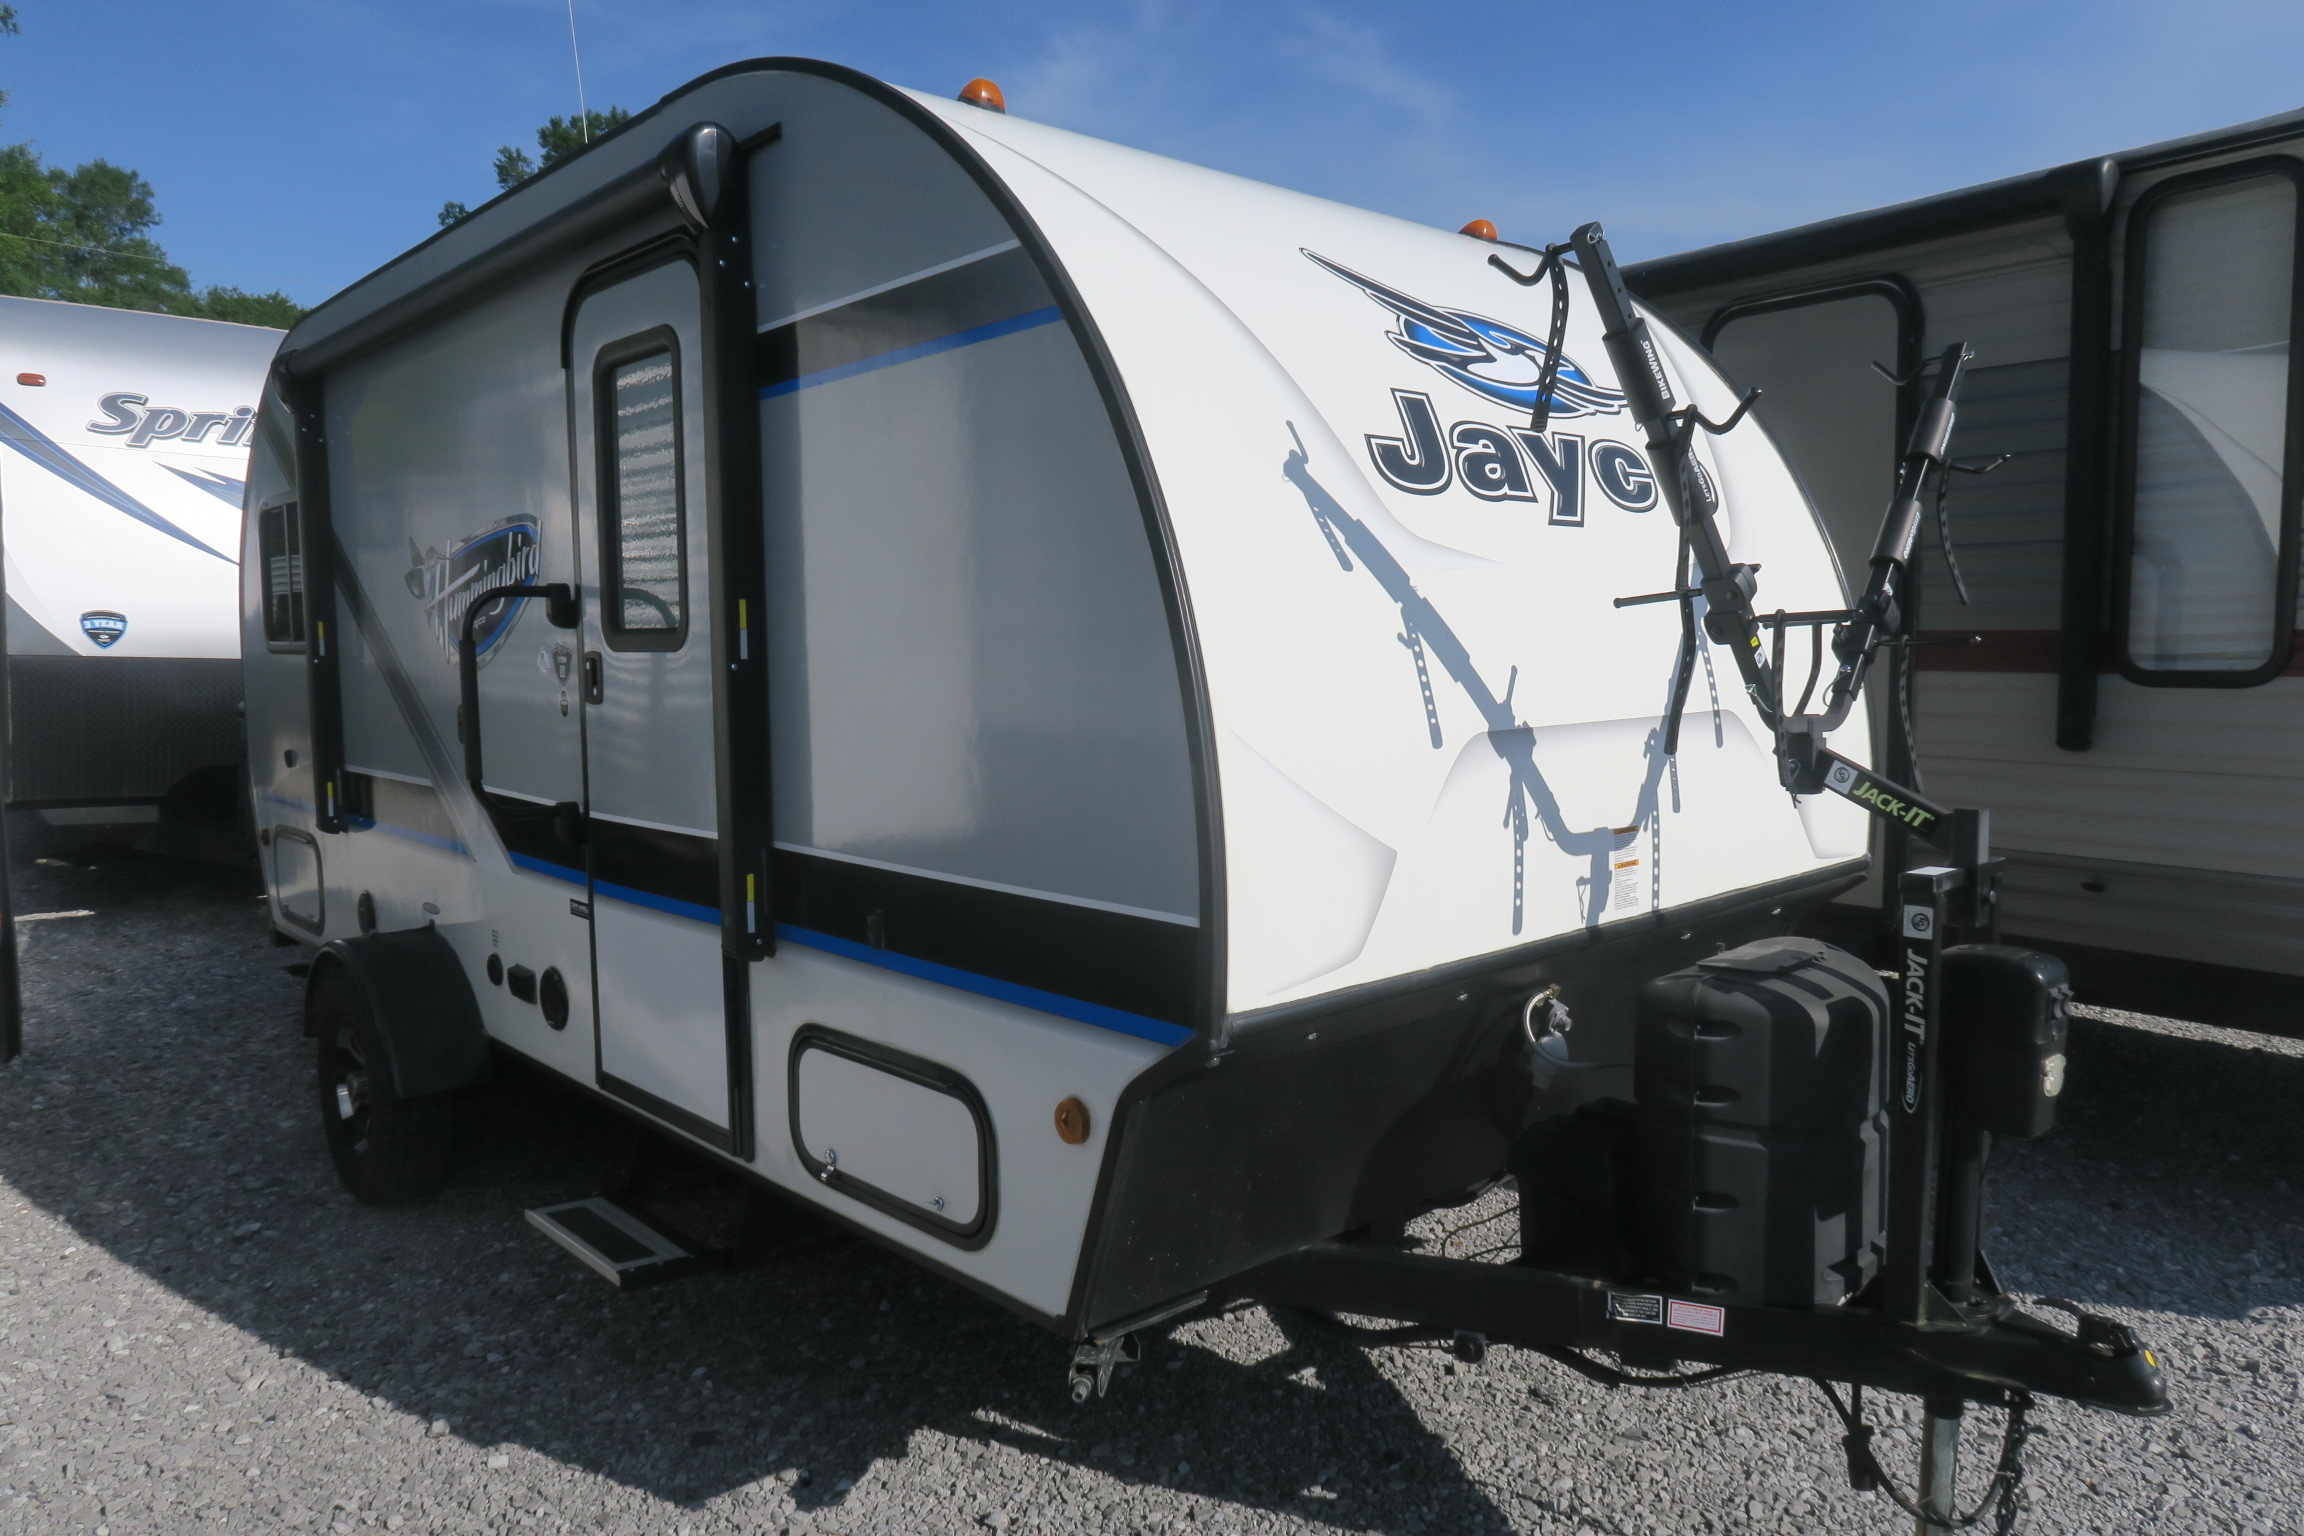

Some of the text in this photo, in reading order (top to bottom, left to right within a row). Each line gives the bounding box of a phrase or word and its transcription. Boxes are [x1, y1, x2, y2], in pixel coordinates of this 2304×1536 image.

[1642, 340, 1671, 400] BIKEWING
[86, 391, 258, 449] Spri
[1364, 387, 1719, 527] Jayc
[424, 518, 542, 664] Hummingbird
[94, 619, 125, 632] YEAR
[1852, 781, 1933, 828] JACK-IT
[1904, 948, 1928, 1040] JACK-IT
